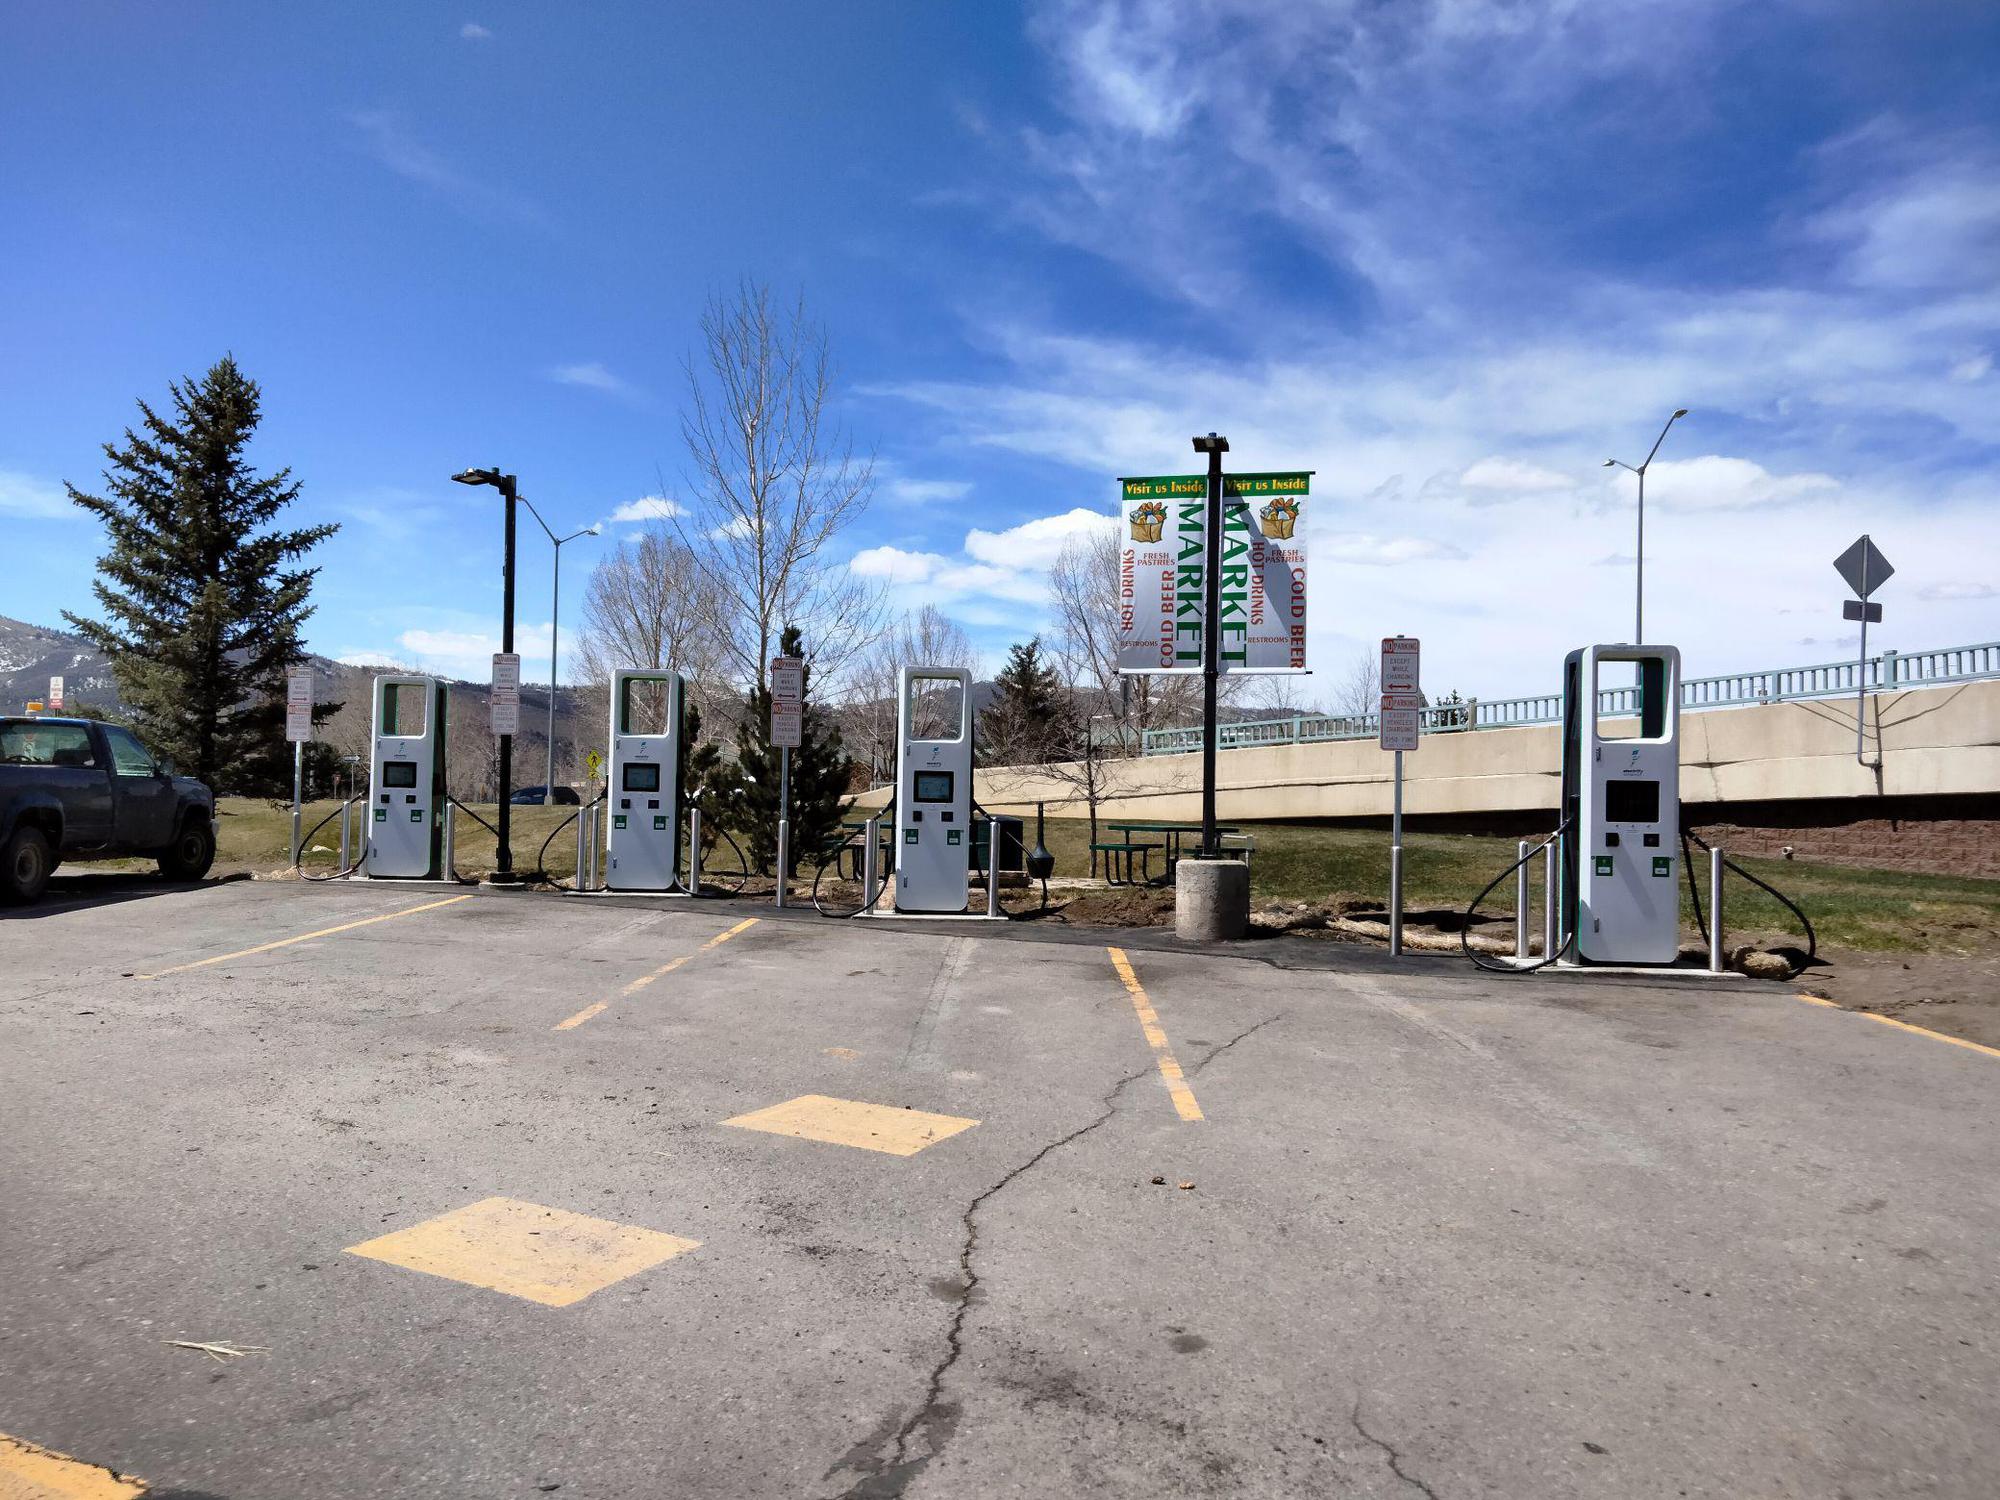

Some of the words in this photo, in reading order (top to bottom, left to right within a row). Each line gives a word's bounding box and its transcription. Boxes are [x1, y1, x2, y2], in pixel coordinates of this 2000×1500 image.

[1126, 482, 1152, 495] Visit
[1155, 484, 1167, 494] us
[1170, 480, 1204, 493] Inside
[1225, 479, 1252, 491] Visit
[1255, 482, 1268, 490] us
[1272, 478, 1307, 490] Inside
[1121, 548, 1136, 598] DRINKS
[1251, 540, 1265, 570] HOT
[1265, 555, 1305, 563] PASTRIES
[1161, 570, 1175, 613] BEER
[1176, 503, 1204, 667] MARKET
[1220, 502, 1250, 667] MARKET
[1250, 575, 1264, 626] DRINKS
[1291, 567, 1306, 618] COLD
[1121, 604, 1134, 631] HOT
[1160, 619, 1174, 668] COLD
[1247, 636, 1289, 644] RESTROOMS
[1290, 624, 1304, 669] BEER
[1383, 640, 1393, 652] NO
[1394, 641, 1417, 650] PARKING
[1382, 697, 1393, 709] NO
[1394, 698, 1416, 706] PARKING
